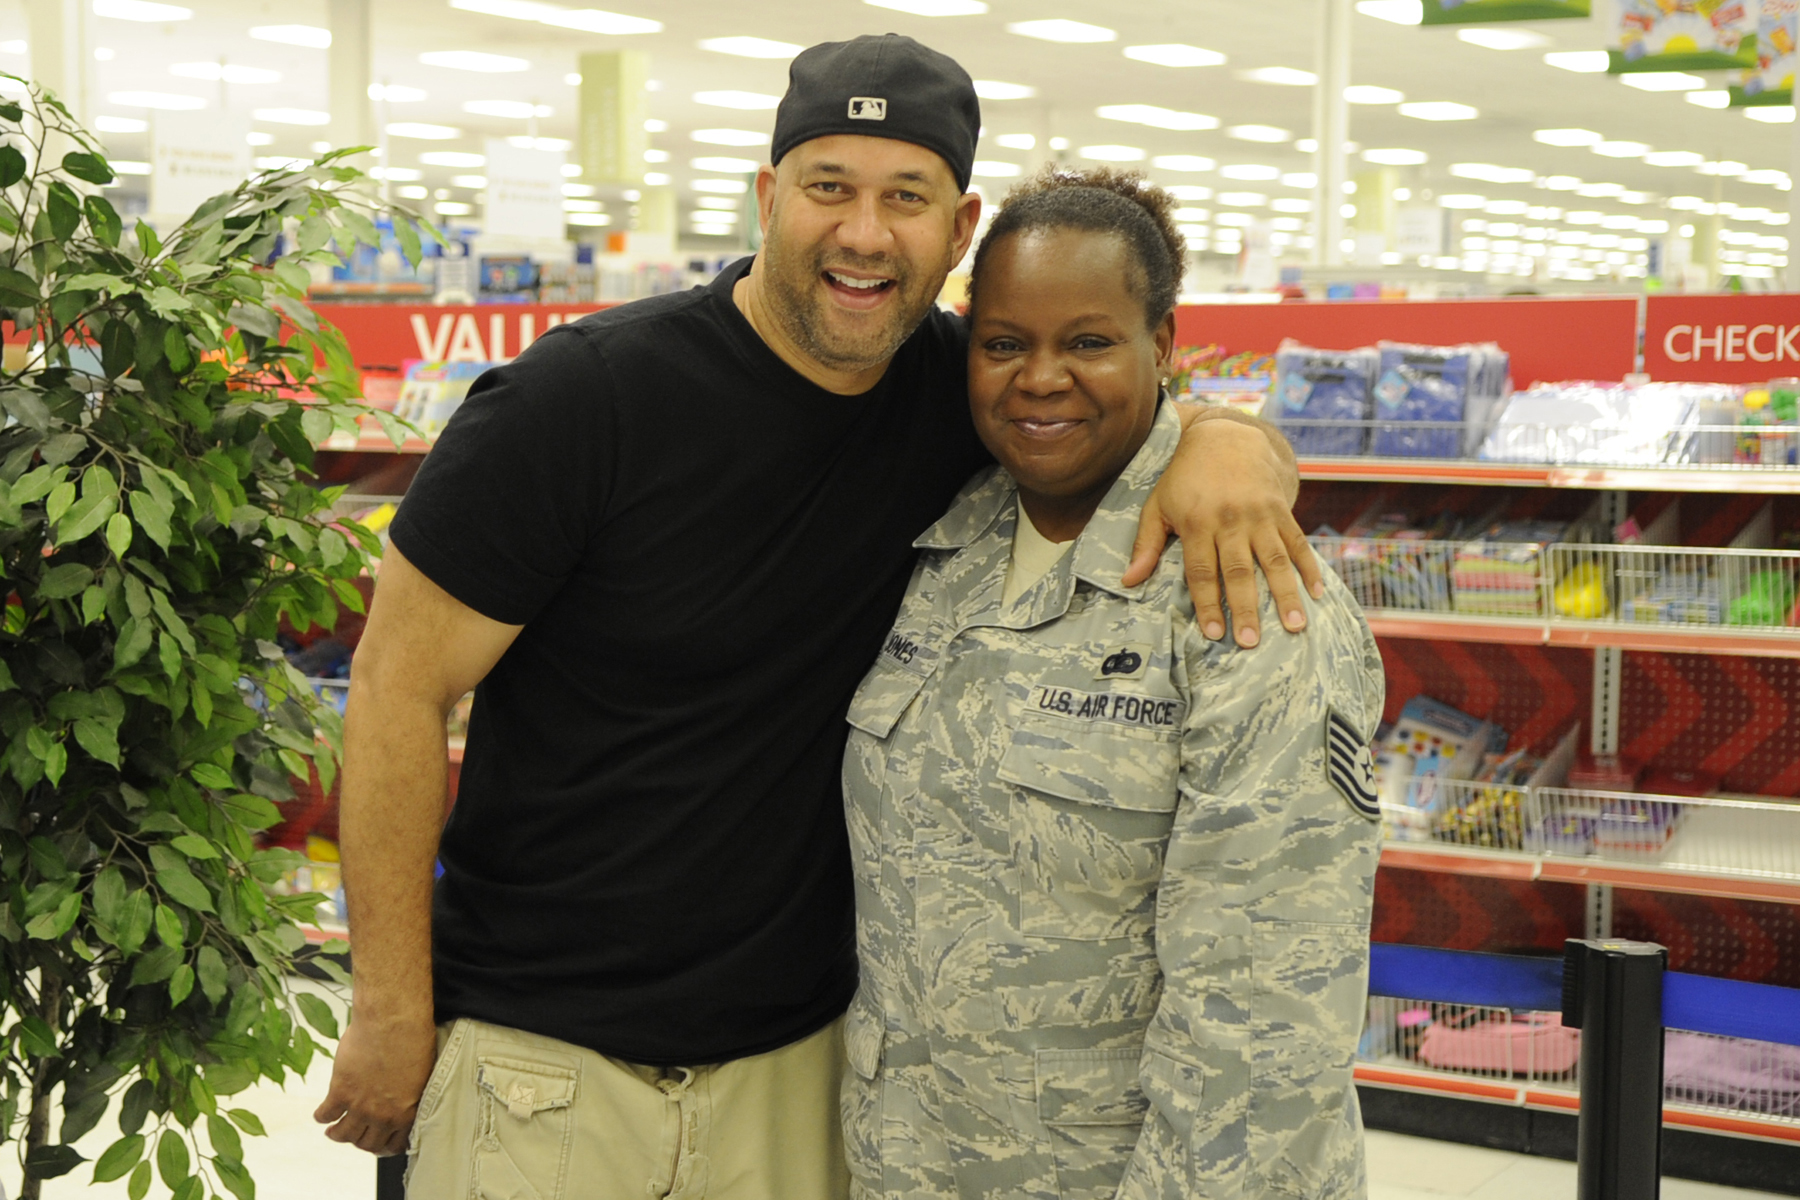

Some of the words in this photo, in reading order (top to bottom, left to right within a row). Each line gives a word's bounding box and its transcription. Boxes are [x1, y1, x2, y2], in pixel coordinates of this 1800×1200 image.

[410, 313, 590, 362] VAL
[1663, 324, 1800, 362] CHECK
[1039, 689, 1072, 715] U.S.
[1077, 694, 1110, 718] AIR
[1113, 696, 1177, 725] FORCE
